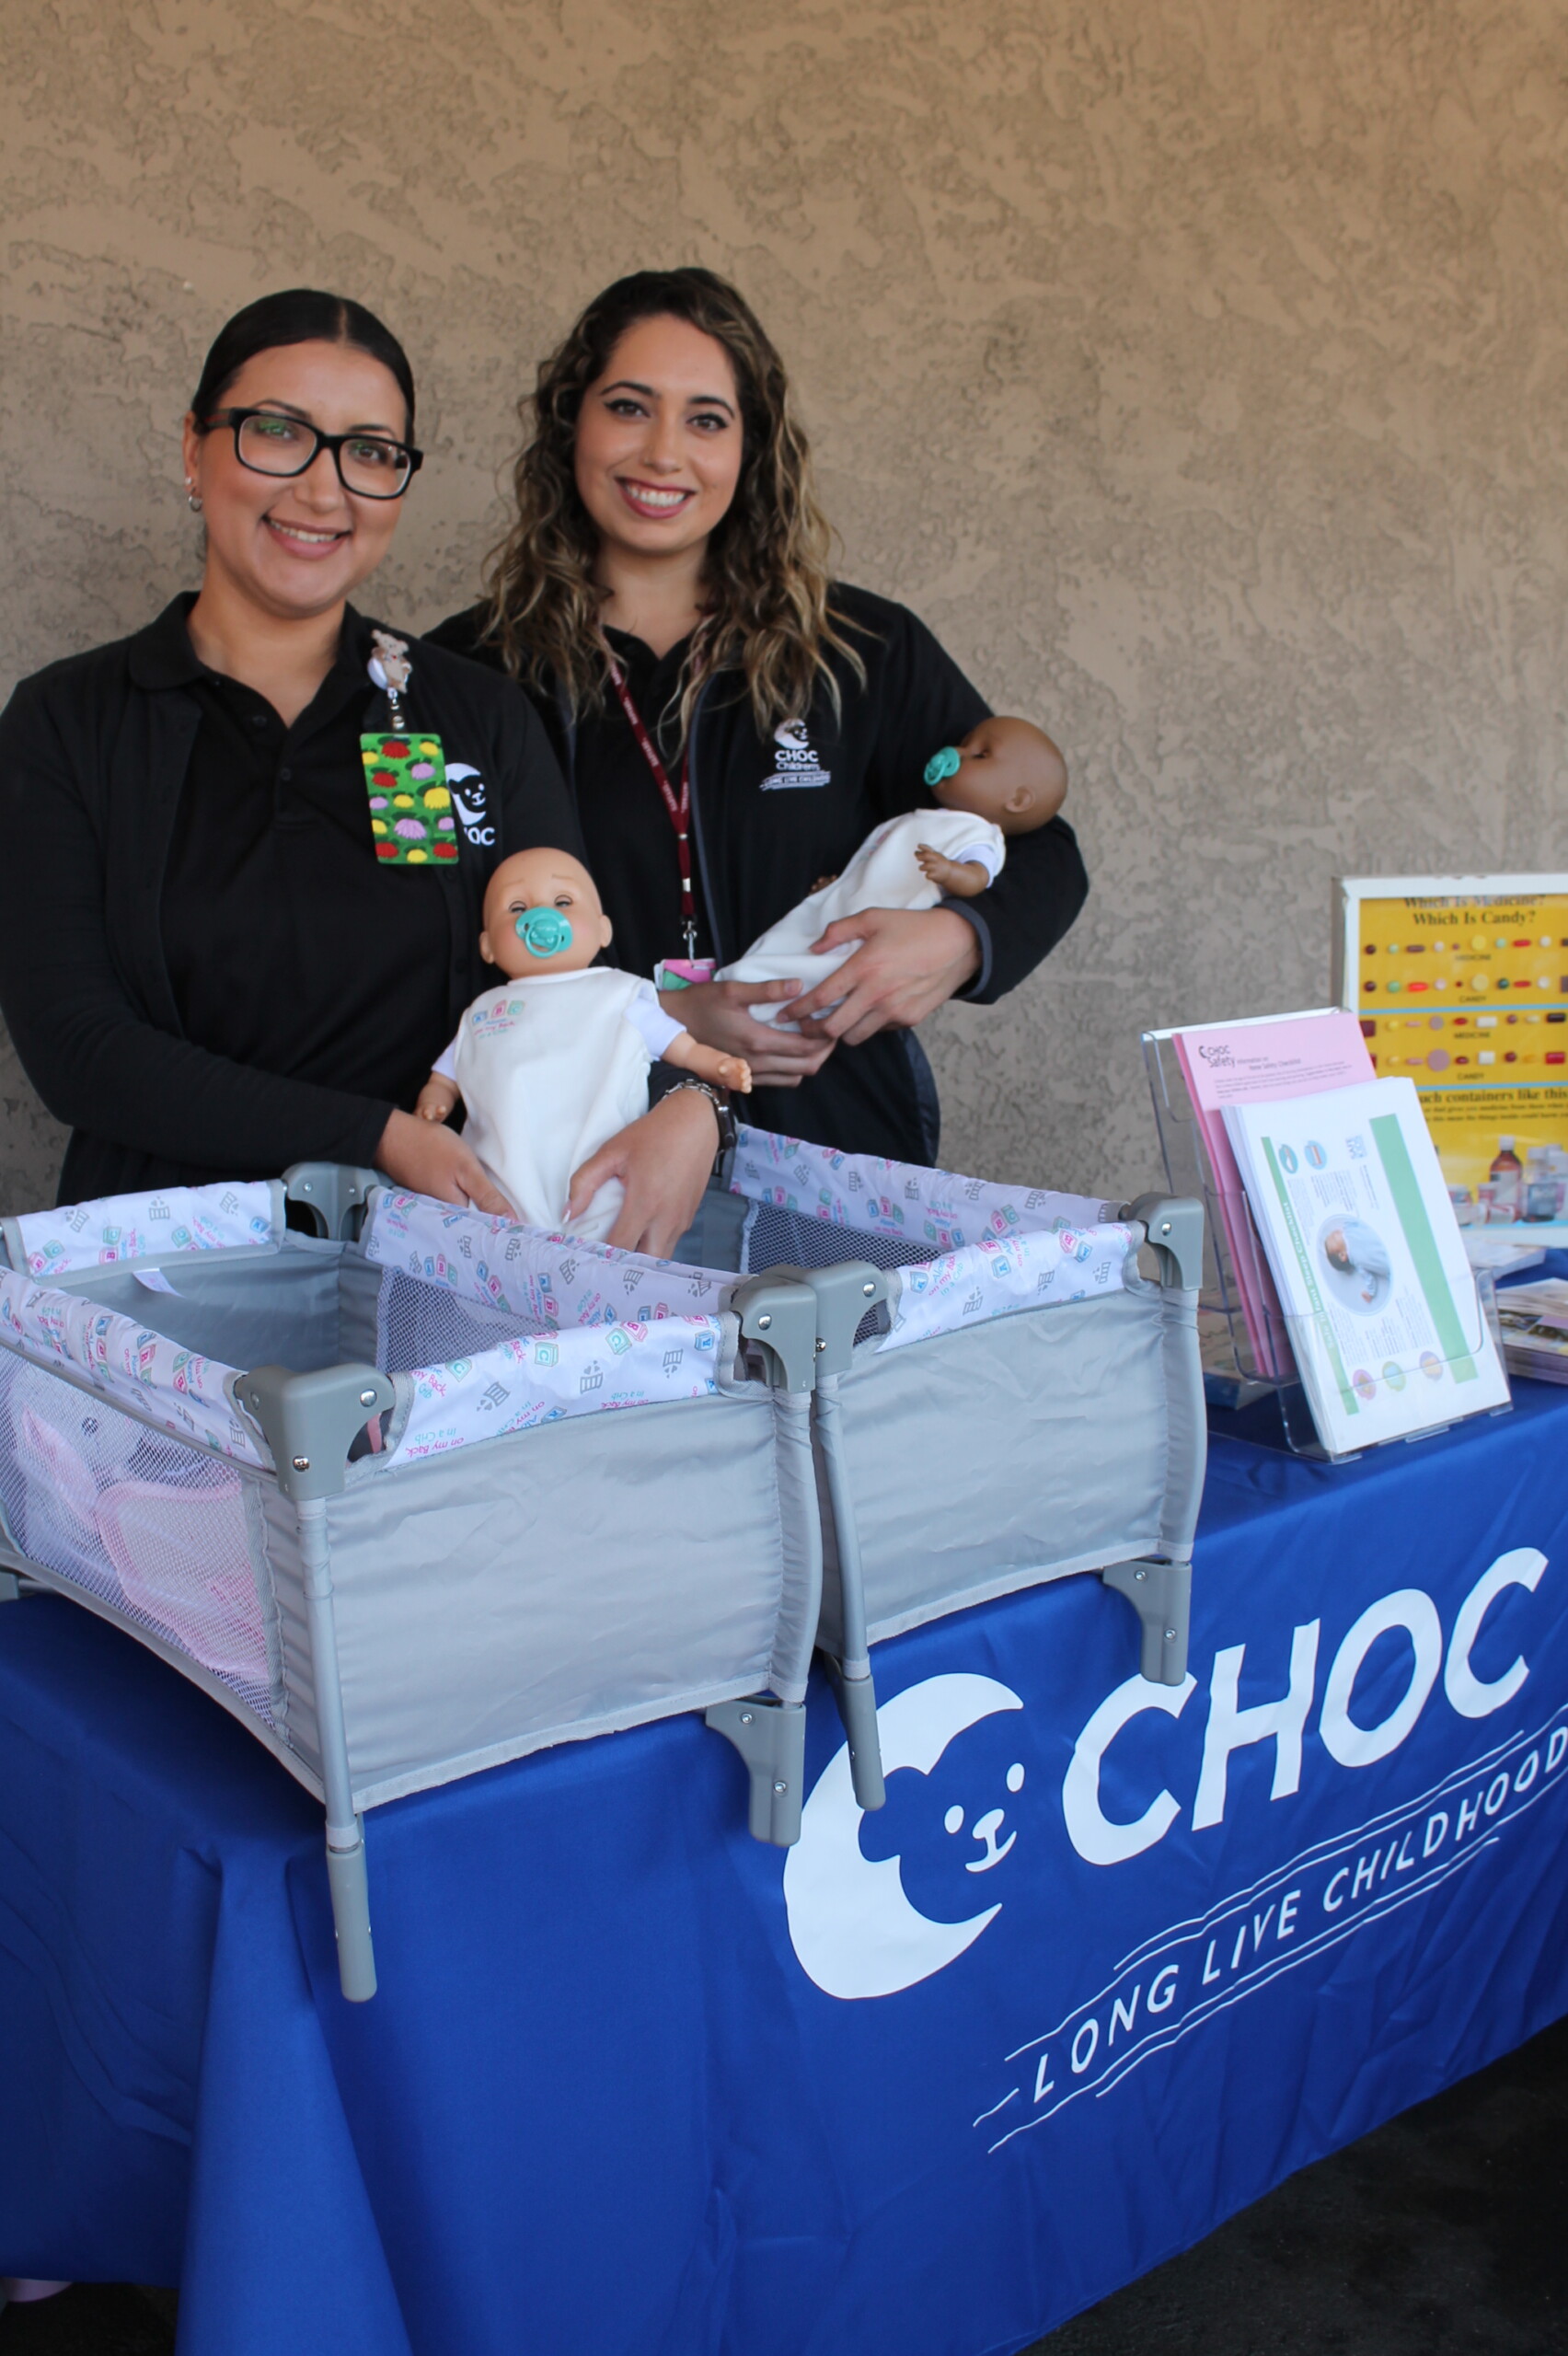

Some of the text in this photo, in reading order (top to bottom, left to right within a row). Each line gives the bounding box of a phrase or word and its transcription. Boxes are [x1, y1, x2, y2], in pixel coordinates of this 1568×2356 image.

[775, 750, 819, 762] CHOC
[464, 827, 495, 846] OC
[1404, 896, 1449, 909] Which
[1455, 896, 1467, 907] Is
[1413, 910, 1536, 927] Which Is Candy?
[1459, 995, 1486, 1003] CANDY
[1207, 1045, 1231, 1057] CHOC
[1207, 1056, 1236, 1068] Safety
[1447, 1089, 1514, 1103] containers
[1518, 1088, 1540, 1101] like
[940, 1271, 951, 1285] my
[516, 1401, 545, 1425] on my
[415, 1431, 436, 1445] Crib
[451, 1437, 465, 1446] on
[432, 1441, 449, 1453] my
[1062, 1546, 1549, 1865] CHOC
[1033, 1726, 1568, 2104] LONG LIVE CHILDHOOD
